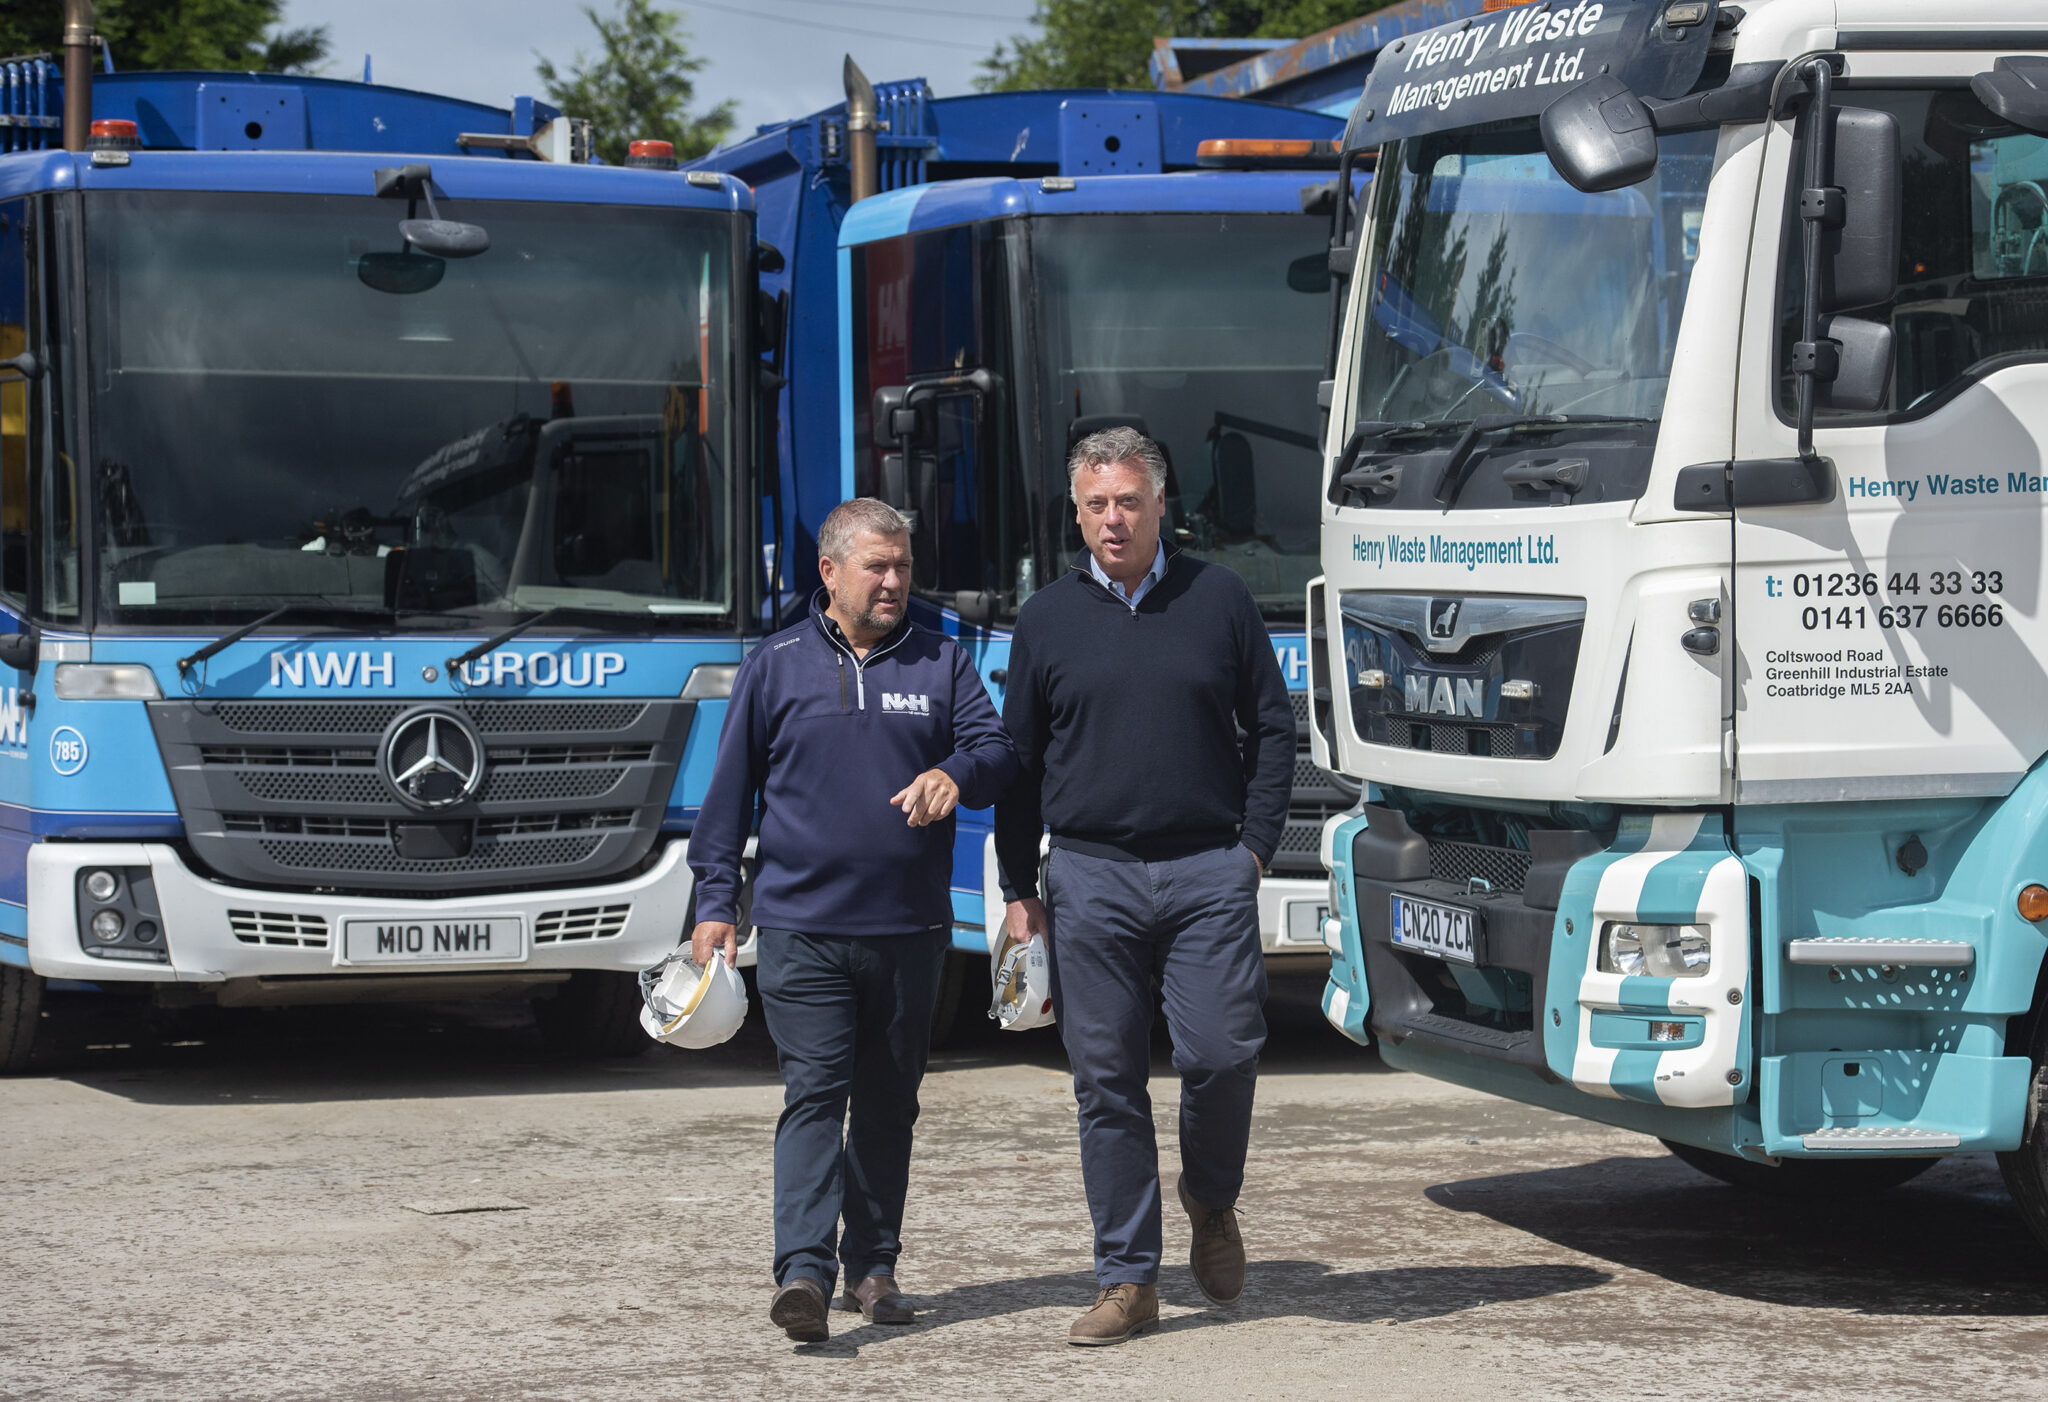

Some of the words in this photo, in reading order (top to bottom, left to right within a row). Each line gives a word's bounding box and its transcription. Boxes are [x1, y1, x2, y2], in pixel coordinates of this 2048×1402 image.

[1404, 22, 1496, 73] Henry
[1498, 0, 1604, 49] Waste
[1386, 57, 1534, 117] Management
[1534, 48, 1585, 86] Ltd.
[1849, 476, 1920, 502] Henry
[1926, 473, 1999, 496] Waste
[1353, 534, 1385, 570] Henry
[1387, 534, 1426, 563] Waste
[1430, 535, 1523, 572] Management
[1527, 534, 1559, 564] Ltd.
[1765, 575, 1783, 598] t:
[1793, 572, 1879, 597] 01236
[1887, 572, 1921, 595] 44
[1929, 571, 1962, 595] 33
[1971, 570, 2003, 594] 33
[1801, 606, 1867, 630] 0141
[1878, 605, 1929, 629] 637
[1937, 603, 2004, 628] 6666
[270, 651, 395, 688] NWH
[458, 651, 626, 688] GROUP
[1766, 650, 1842, 664] Coltswood
[1847, 649, 1883, 662] Road
[1766, 667, 1831, 681] Greenhill
[1835, 665, 1901, 680] Industrial
[1905, 665, 1949, 678] Estate
[882, 692, 930, 713] NWH
[1404, 674, 1484, 718] MAN
[1766, 683, 1846, 698] Coatbridge
[1850, 683, 1881, 696] ML5
[1884, 682, 1914, 696] 2AA
[54, 741, 81, 761] 785
[433, 924, 491, 953] NWH
[1402, 902, 1441, 945] CN20
[1443, 911, 1473, 952] ZCA
